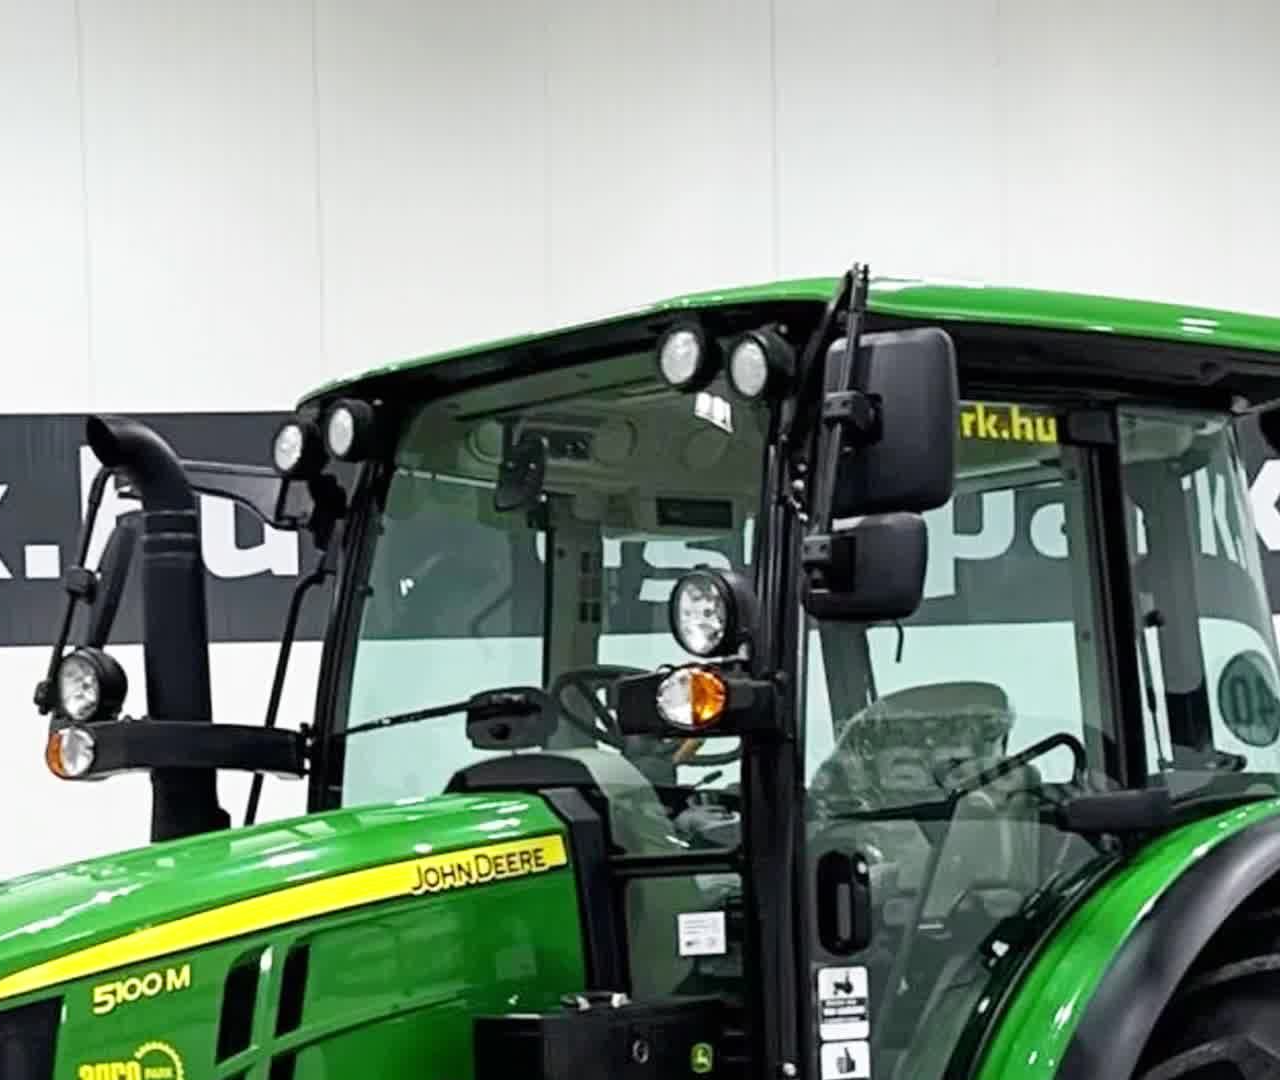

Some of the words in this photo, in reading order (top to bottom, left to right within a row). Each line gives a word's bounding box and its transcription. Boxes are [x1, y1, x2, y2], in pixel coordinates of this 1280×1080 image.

[411, 861, 473, 890] JOHN
[474, 848, 546, 878] DEERE
[93, 972, 162, 1014] 5100
[166, 964, 191, 992] M
